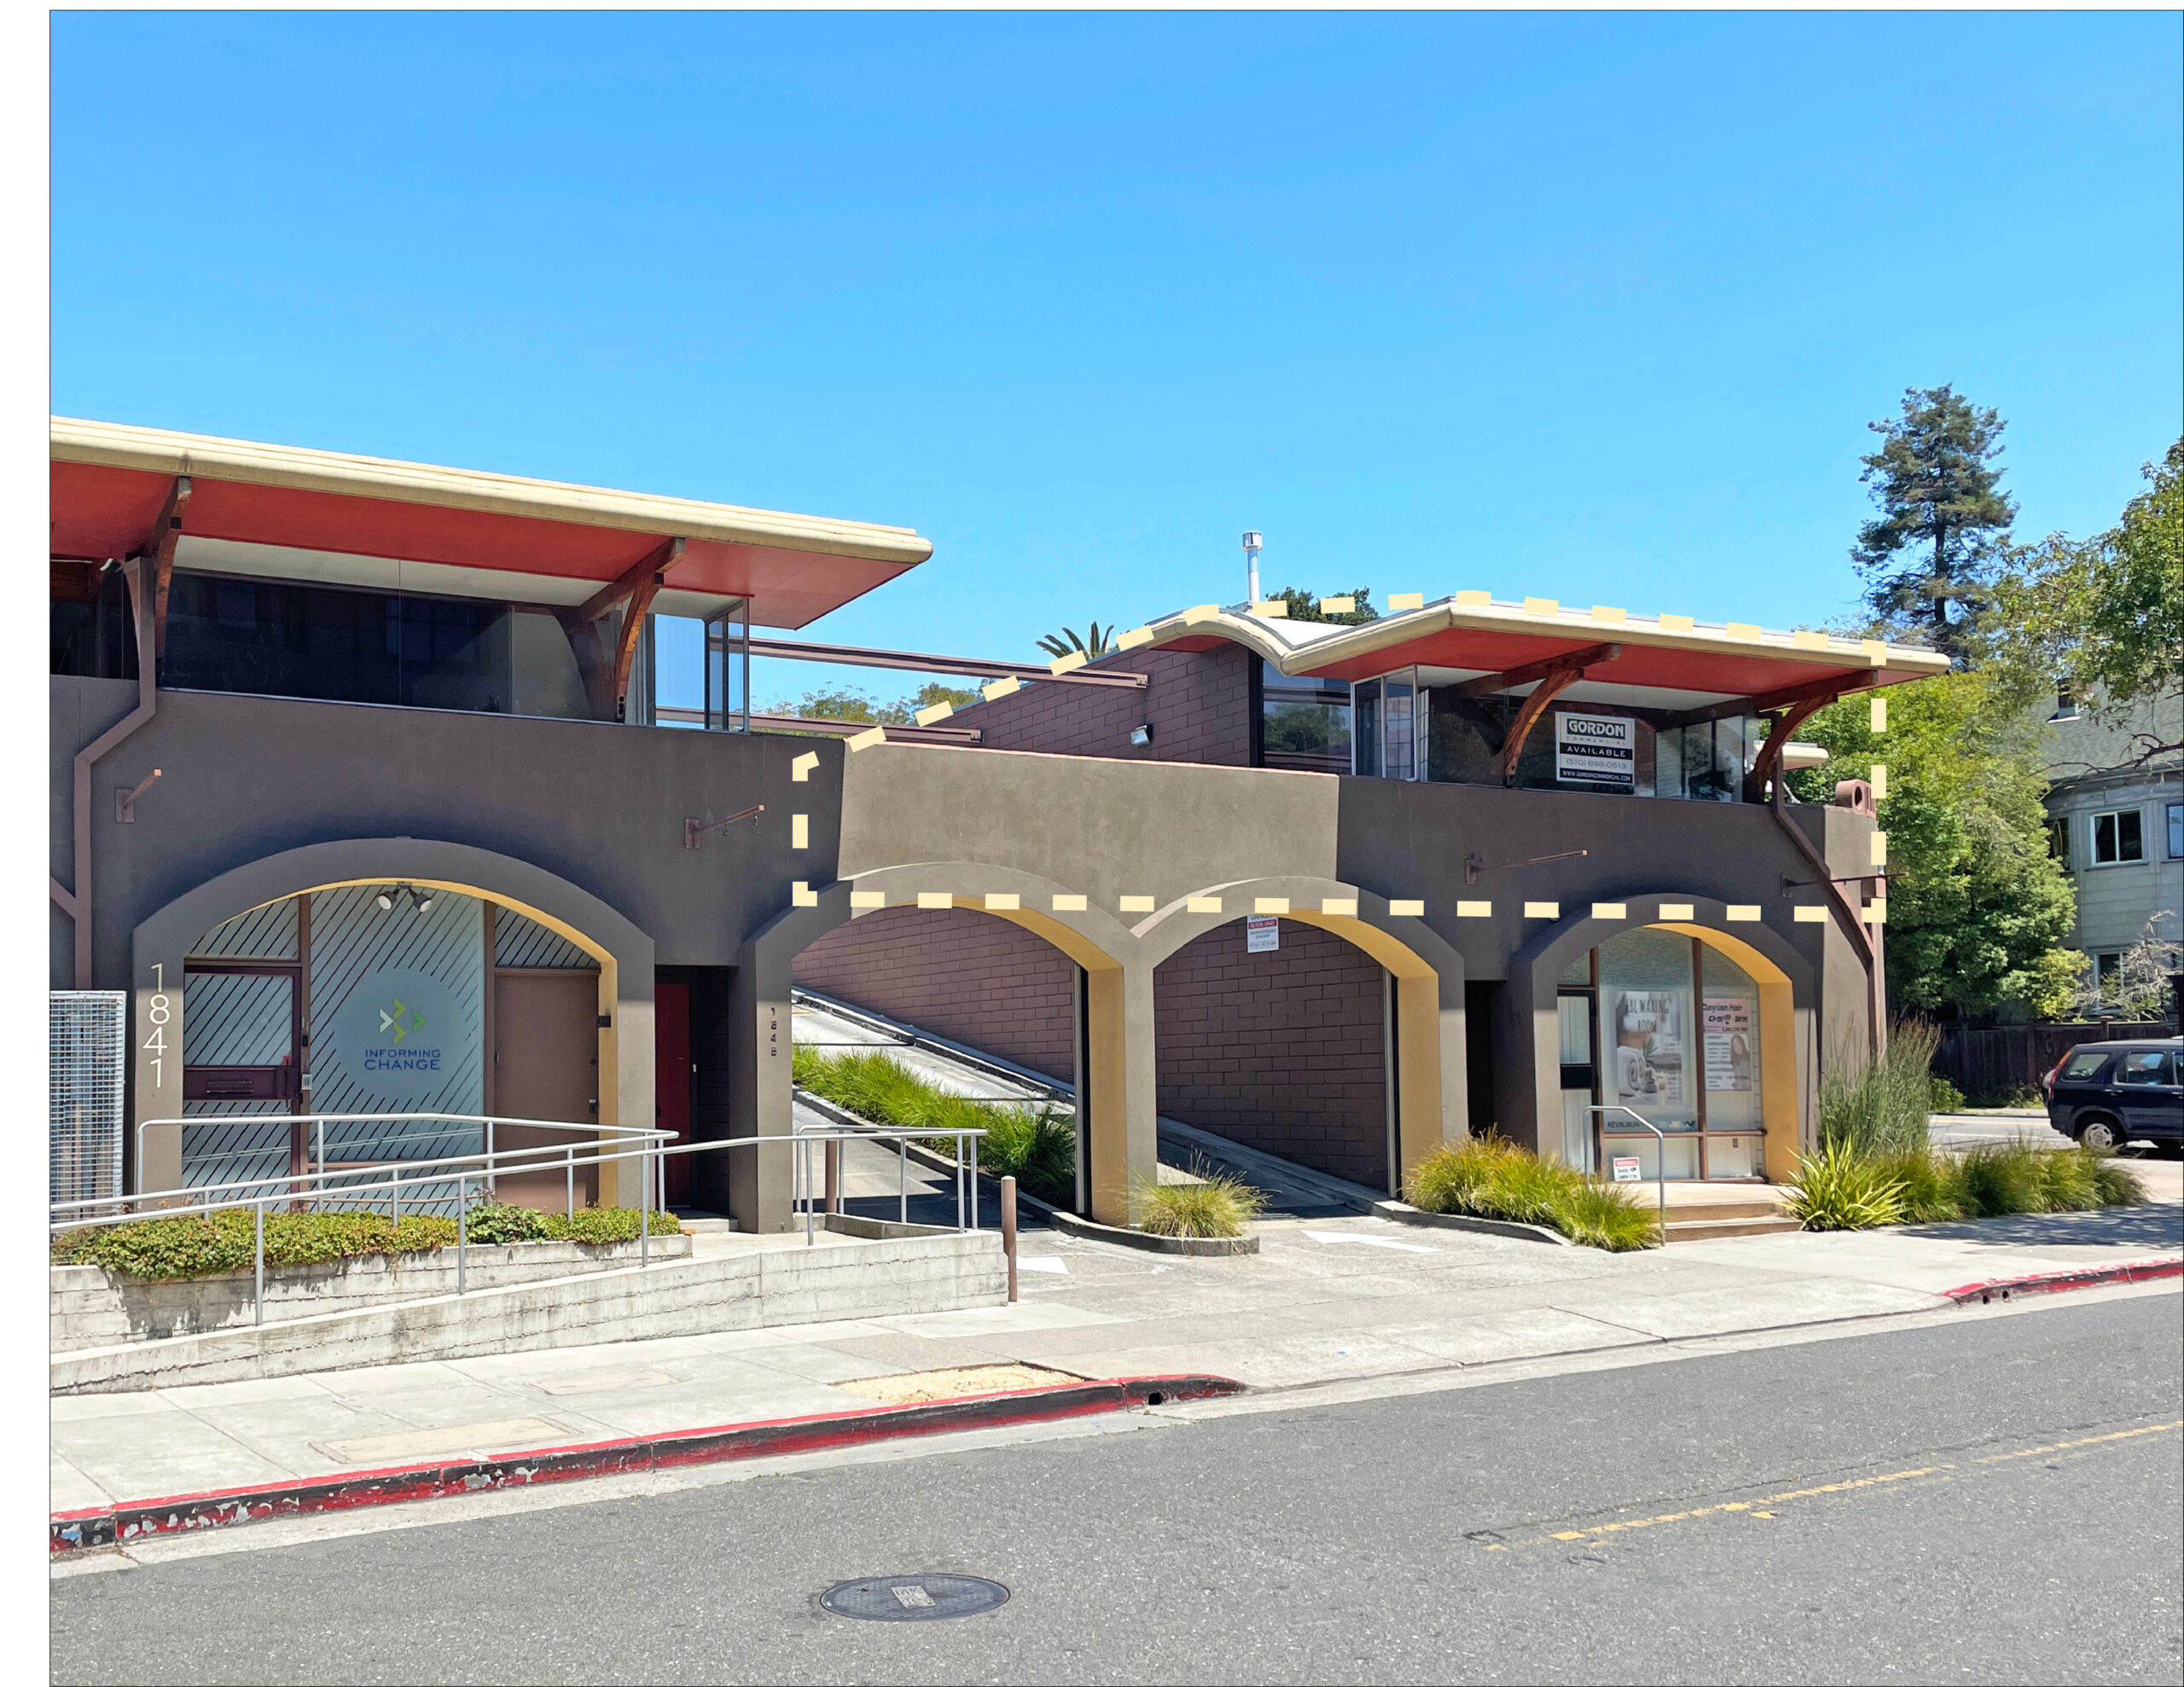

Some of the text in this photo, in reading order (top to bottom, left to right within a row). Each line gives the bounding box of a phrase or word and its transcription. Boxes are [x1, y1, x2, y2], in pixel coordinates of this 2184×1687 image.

[1568, 720, 1624, 738] GORDON
[1566, 736, 1626, 745] COMMERCIAL
[1567, 746, 1626, 757] AVAILABLE
[1566, 757, 1586, 767] (510)
[1639, 999, 1670, 1013] WAXING
[142, 963, 171, 1088] 1841
[365, 1049, 441, 1058] INFORMING
[364, 1059, 440, 1070] CHANGE
